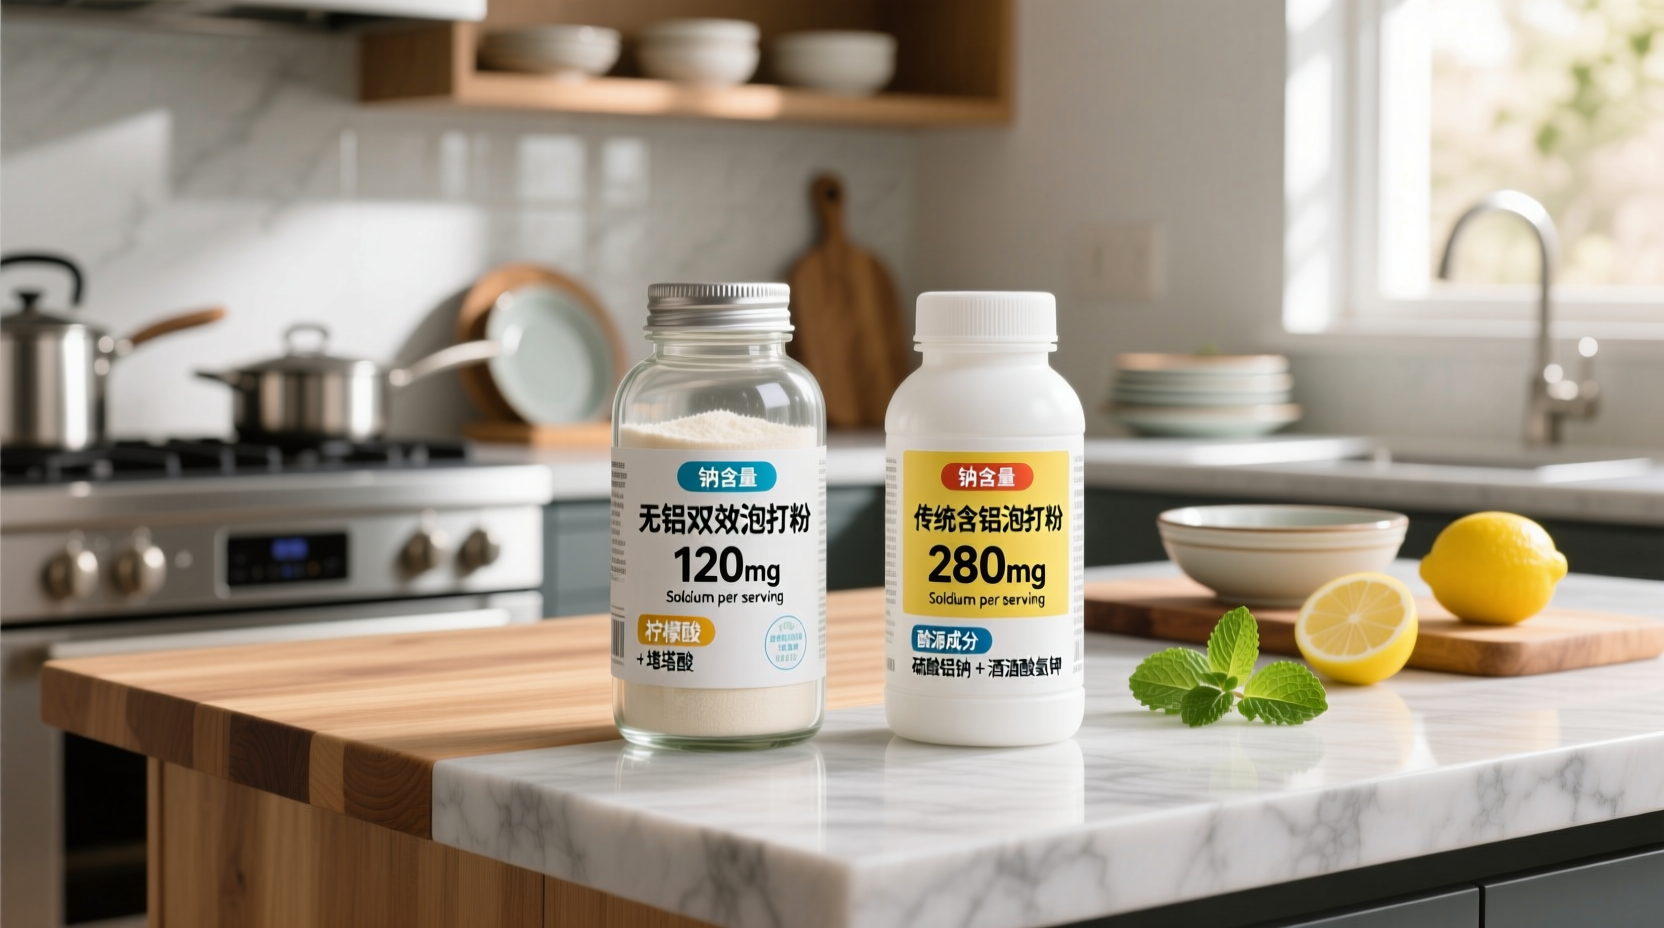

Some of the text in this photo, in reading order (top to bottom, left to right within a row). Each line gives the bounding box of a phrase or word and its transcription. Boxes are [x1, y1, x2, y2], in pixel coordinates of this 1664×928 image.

[698, 466, 757, 488] 钠含量
[958, 466, 1015, 488] 钠含量
[638, 502, 811, 535] 无铝双效泡打粉
[913, 503, 1063, 533] 传统含铝泡打粉
[674, 546, 780, 587] 120mg
[928, 545, 1046, 589] 280mg
[718, 592, 738, 607] per
[741, 590, 784, 605] serving
[980, 595, 1000, 609] per
[1003, 591, 1045, 608] serving
